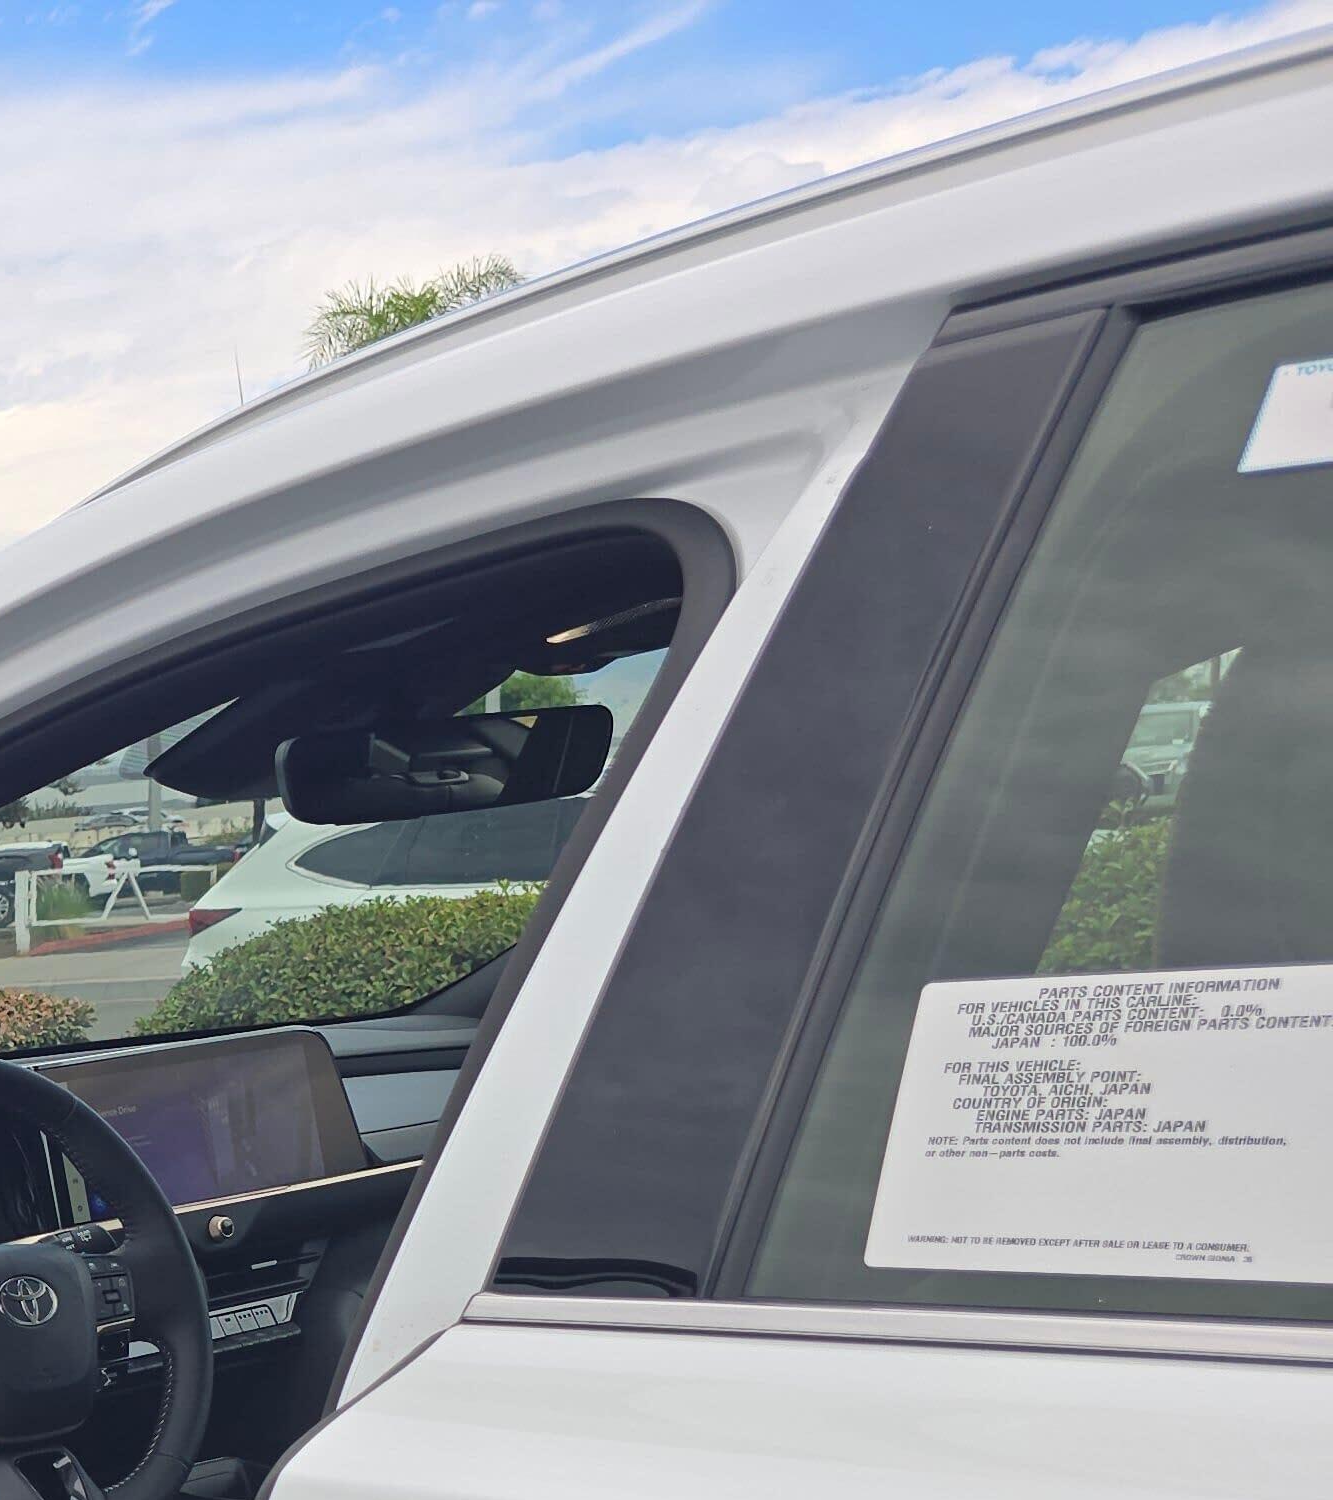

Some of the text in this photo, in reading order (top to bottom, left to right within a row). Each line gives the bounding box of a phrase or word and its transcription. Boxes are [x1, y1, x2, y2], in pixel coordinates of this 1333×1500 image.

[1039, 977, 1281, 1000] PARTS CONTENT INFORMATION
[957, 994, 1198, 1015] FOR VEHICLES IN THIS CARLINE:
[971, 1004, 1263, 1026] U.S./CANADA PARTS CONTENT: 0.0%
[968, 1024, 1019, 1038] MAJOR
[1024, 1022, 1093, 1036] SOURCES
[1099, 1021, 1120, 1034] OF
[1124, 1019, 1191, 1033] FOREIGN
[1197, 1017, 1250, 1031] PARTS
[992, 1036, 1040, 1049] JAPAN
[1063, 1034, 1117, 1048] 100.0%
[944, 1059, 1081, 1074] FOR THIS VEHICLE:
[958, 1070, 1142, 1086] FINAL ASSEMBLY POINT:
[1099, 1083, 1151, 1095] JAPAN
[952, 1096, 1108, 1110] COUNTRY OF ORIGIN:
[976, 1108, 1146, 1121] ENGINE PARTS: JAPAN
[975, 1120, 1207, 1134] TRANSMISSION PARTS: JAPAN
[928, 1136, 958, 1146] NOTE:
[962, 1136, 989, 1146] Parts
[991, 1136, 1031, 1146] content
[1034, 1136, 1060, 1146] does
[1064, 1136, 1081, 1146] not
[1084, 1135, 1125, 1146] include
[938, 1149, 965, 1158] other
[907, 1235, 949, 1244] WARNING:
[951, 1235, 967, 1244] NOT
[970, 1236, 981, 1245] TO
[983, 1236, 993, 1245] BE
[996, 1236, 1036, 1246] REMOVED
[1038, 1238, 1071, 1247] EXCEPT
[1073, 1239, 1100, 1248] AFTER
[1102, 1240, 1125, 1249] SALE
[1127, 1240, 1139, 1249] OR
[1142, 1241, 1170, 1250] LEASE
[1173, 1242, 1184, 1250] TO
[1186, 1242, 1193, 1250] A
